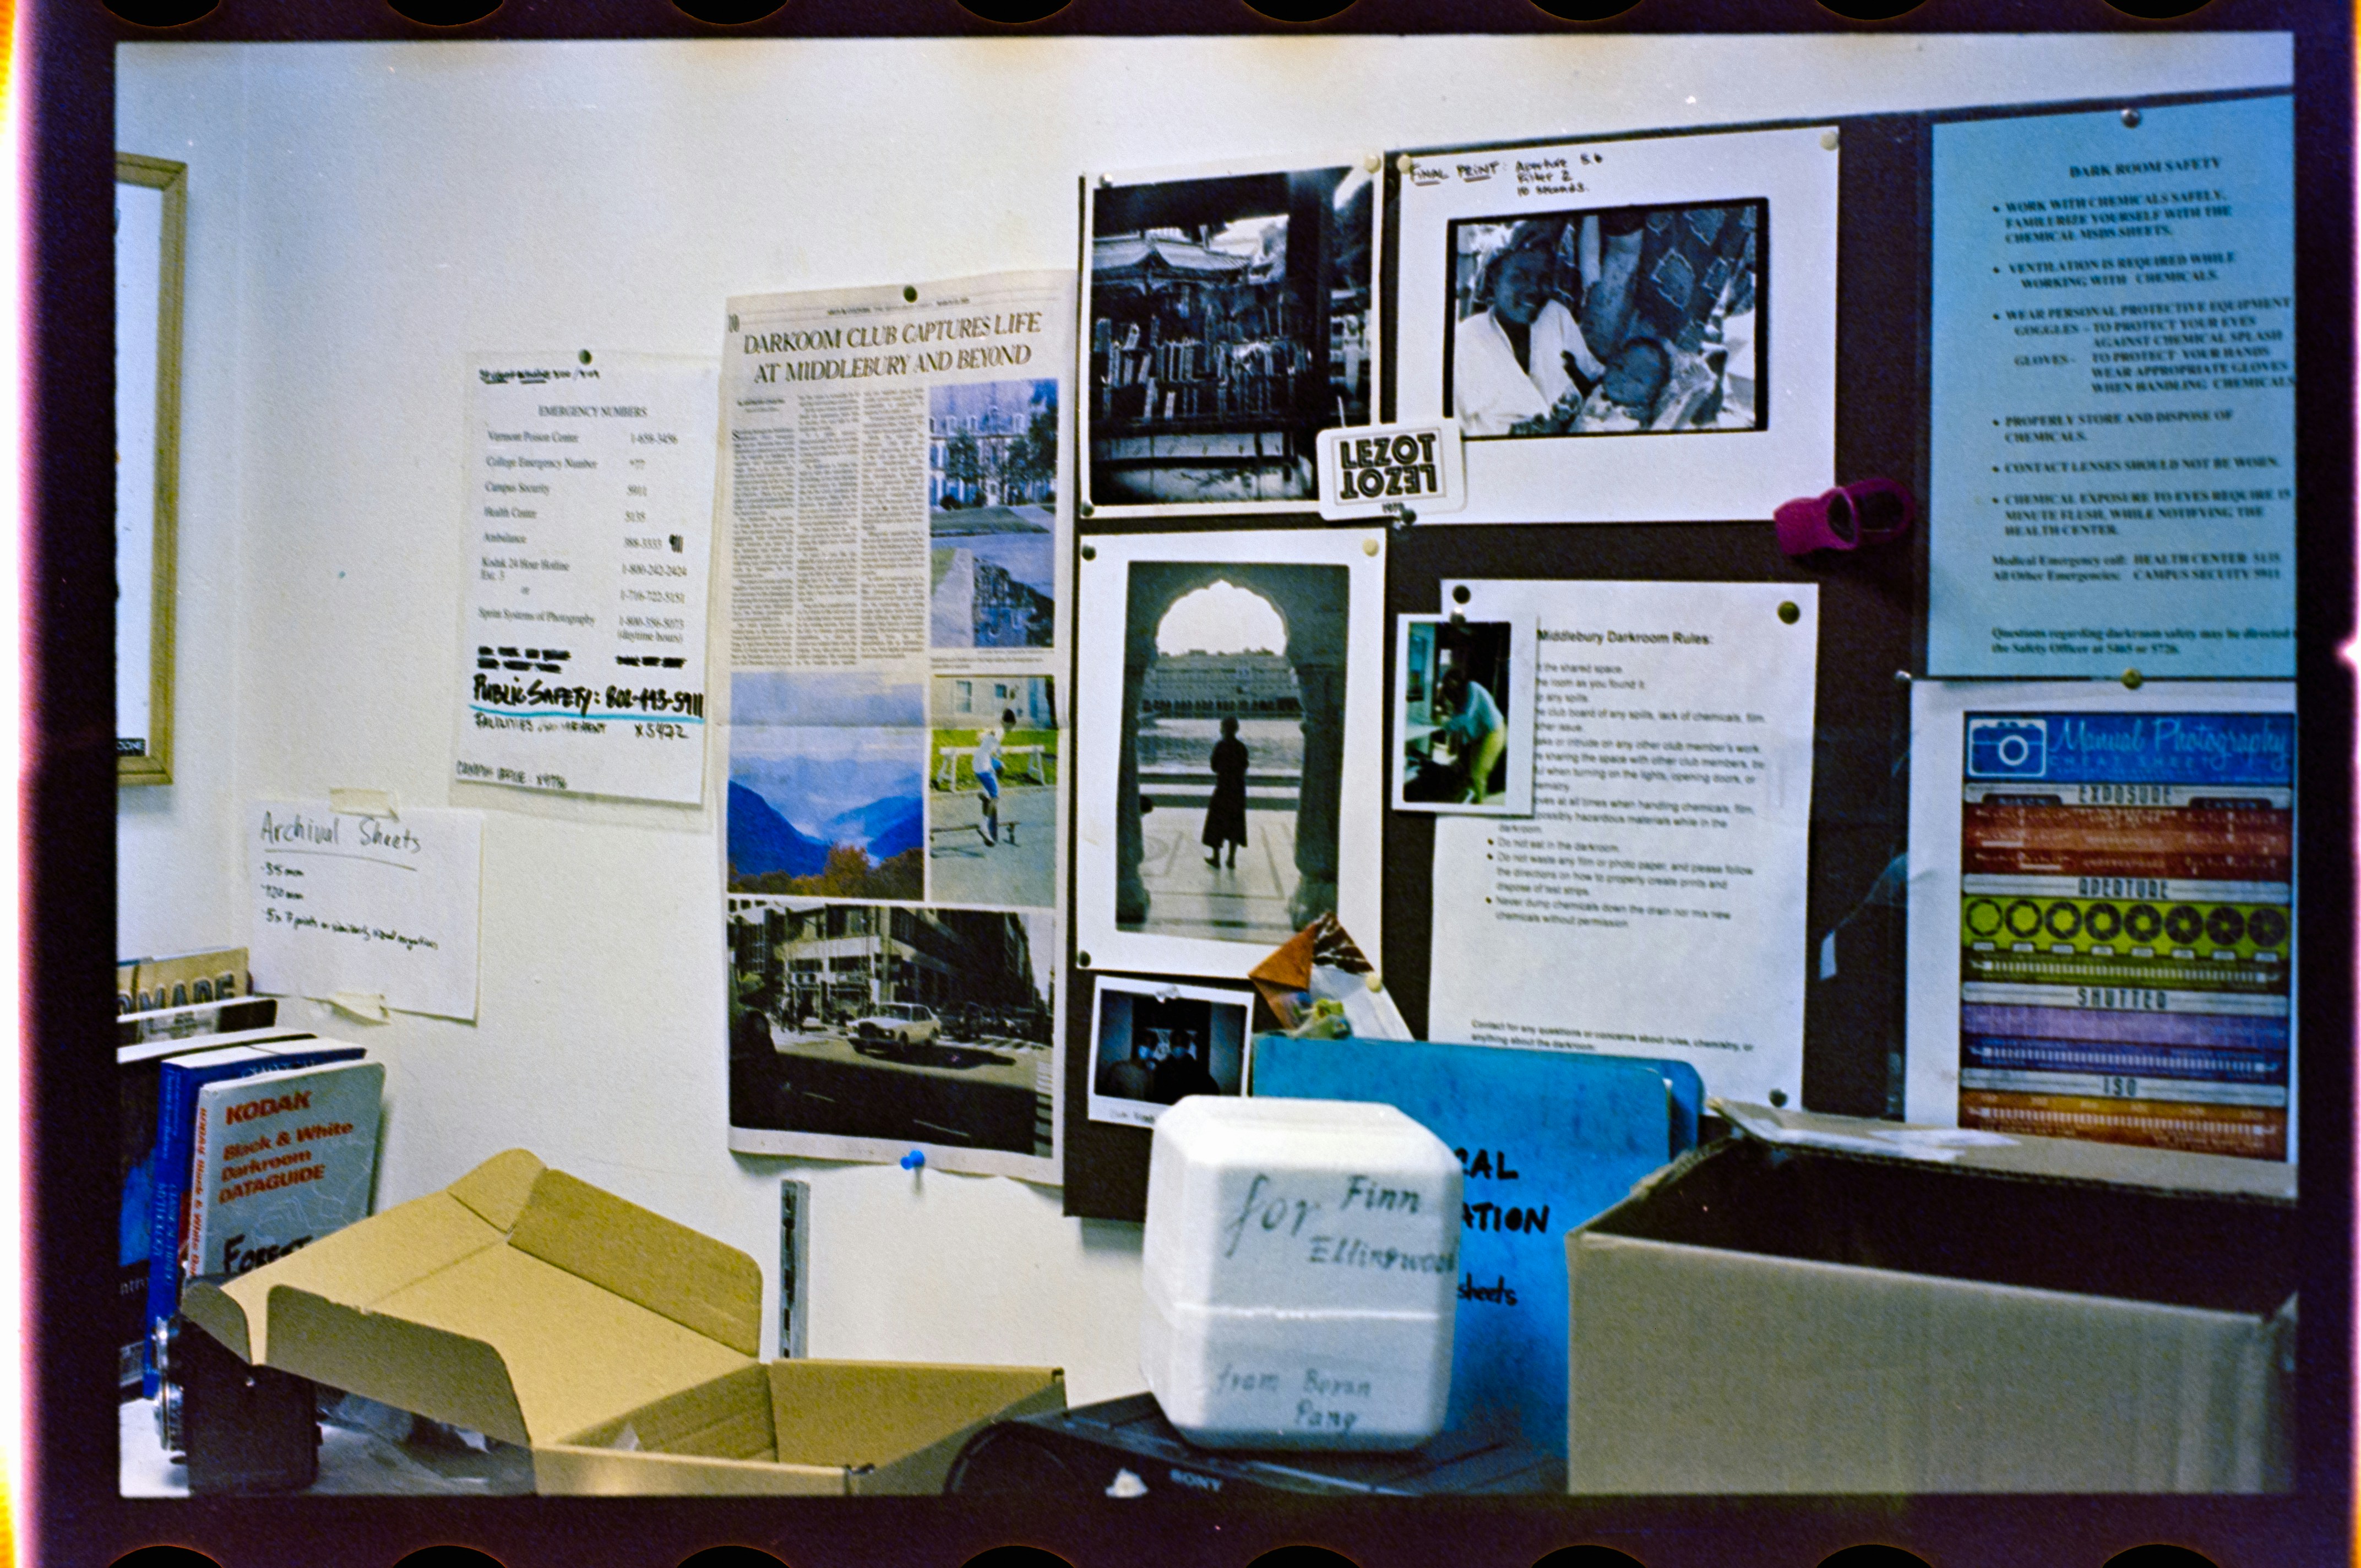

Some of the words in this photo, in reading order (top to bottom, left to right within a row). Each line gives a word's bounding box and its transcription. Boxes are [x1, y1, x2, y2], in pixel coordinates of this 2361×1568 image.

[2069, 165, 2112, 178] DARK
[2115, 162, 2161, 175] ROOM
[2164, 156, 2220, 173] SAFETY
[2005, 202, 2046, 212] WORK
[2049, 198, 2086, 209] WITH
[2088, 194, 2168, 208] CHEMICALS
[2091, 211, 2160, 224] YOURSELF
[2164, 208, 2201, 219] WITH
[2205, 205, 2231, 216] THE
[2005, 231, 2075, 244] CHEMICAL
[2009, 262, 2099, 274] VENTILATION
[2102, 259, 2114, 269] IS
[2118, 254, 2187, 270] REQUIRED
[2190, 252, 2235, 264] WHILE
[2021, 277, 2087, 288] WORKING
[2090, 275, 2126, 286] WITH
[2005, 308, 2045, 320] WEAR
[2048, 307, 2117, 319] PERSONAL
[2120, 302, 2204, 315] PROTECTIVE
[2209, 298, 2290, 313] EQUIPMENT
[744, 329, 841, 355] DARKOOM
[847, 325, 896, 347] CLUB
[900, 317, 990, 344] CAPTURES
[994, 312, 1041, 335] LIFE
[754, 362, 781, 383] AT
[785, 353, 910, 382] MIDDLEBURY
[913, 351, 953, 372] AND
[956, 345, 1031, 369] BEYOND
[538, 405, 598, 417] EMERGENCY
[601, 406, 647, 417] NUMBERS
[2005, 415, 2073, 427] PROPERLY
[2079, 413, 2121, 425] STORE
[2126, 412, 2153, 423] AND
[2156, 411, 2211, 422] DISPOSE
[2215, 410, 2234, 420] OF
[488, 431, 521, 440] Vermont
[552, 432, 578, 442] Center
[1340, 433, 1435, 469] LEZOT
[519, 458, 562, 469] Emergency
[564, 459, 598, 468] Number
[2005, 462, 2069, 473] CONTACT
[2071, 461, 2121, 472] LENSES
[2124, 459, 2179, 471] SHOULD
[2182, 459, 2209, 469] NOT
[2213, 458, 2231, 469] BE
[512, 509, 537, 518] Center
[483, 533, 526, 543] Ambulance
[481, 558, 507, 569] Kodak
[520, 559, 539, 569] Hour
[541, 560, 570, 571] Hotline
[1993, 555, 2037, 567] Medical
[2039, 554, 2100, 568] Emergency
[2134, 554, 2189, 565] HEALTH
[2192, 553, 2246, 564] CENTER
[1994, 570, 2009, 581] All
[2011, 570, 2042, 581] Other
[2134, 569, 2189, 580] CAMPUS
[504, 608, 534, 621] Systems
[536, 610, 546, 620] of
[548, 612, 595, 627] Photography
[1537, 629, 1603, 645] Middlebury
[1607, 630, 1669, 644] Darkroom
[473, 673, 526, 706] PUBLIC
[2048, 720, 2144, 752] Manual
[2152, 718, 2289, 770] Photography
[2079, 786, 2172, 805] EXPOSURE
[260, 811, 339, 844] Archival
[360, 817, 421, 853] Sheets
[2078, 878, 2169, 899] APERTURE
[2077, 988, 2167, 1009] SHUTTER
[2103, 1079, 2136, 1096] ISO
[225, 1091, 313, 1126] KODAK
[222, 1136, 271, 1162] Black
[277, 1133, 291, 1146] &
[296, 1123, 353, 1142] White
[221, 1151, 312, 1182] Darkroom
[219, 1164, 325, 1205] DATAGUIDE
[1225, 1173, 1320, 1260] for
[1339, 1174, 1421, 1215] Finn
[1169, 1469, 1222, 1491] SONY
